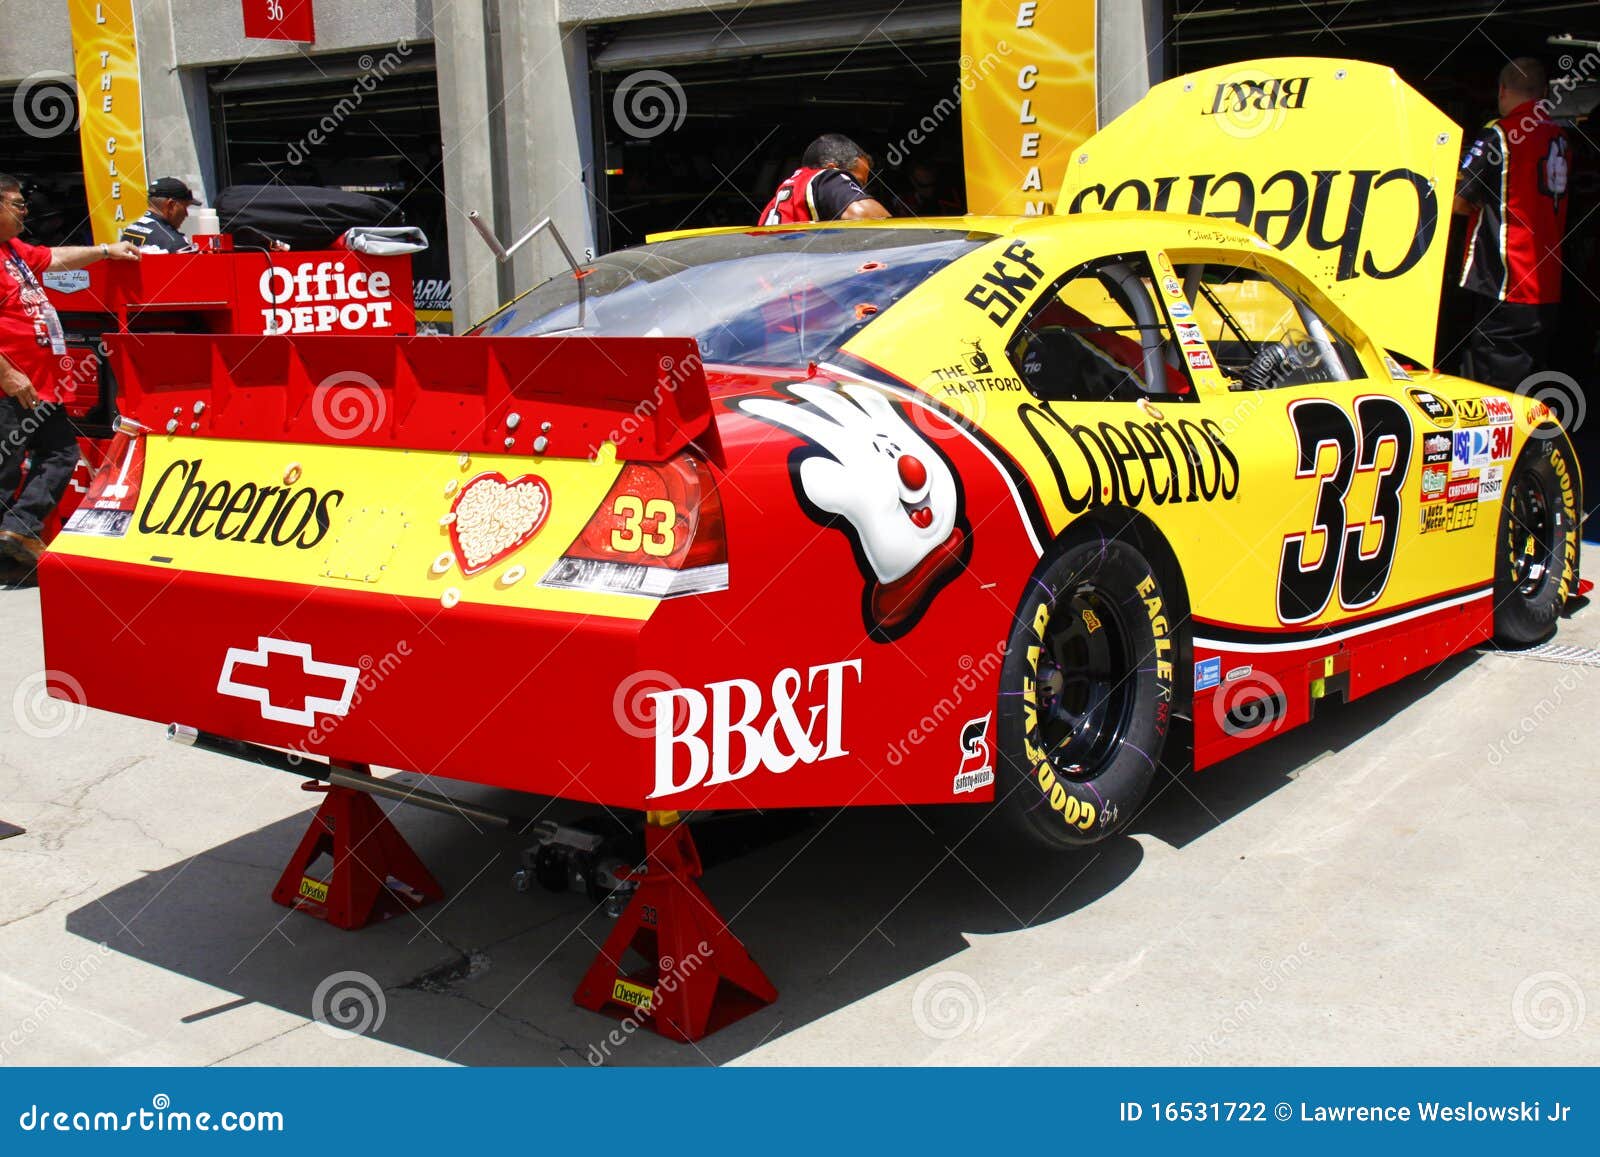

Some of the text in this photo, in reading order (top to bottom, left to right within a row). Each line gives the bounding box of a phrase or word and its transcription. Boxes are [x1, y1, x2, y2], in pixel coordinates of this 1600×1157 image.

[266, 0, 284, 21] 36
[100, 50, 113, 114] THE
[1202, 77, 1313, 115] BB&T
[259, 262, 391, 305] Office
[963, 239, 1045, 328] SKF
[260, 302, 392, 336] DEPOT
[932, 363, 968, 381] THE
[942, 376, 1022, 396] HARTFORD
[1017, 401, 1240, 514] Cheerios
[1491, 426, 1513, 460] 3M
[138, 459, 344, 549] Cheerios
[611, 495, 676, 557] 33
[1276, 394, 1415, 627] 33
[1136, 574, 1173, 683] EAGLE
[645, 658, 862, 800] BB&T
[614, 983, 651, 1009] Cheerios
